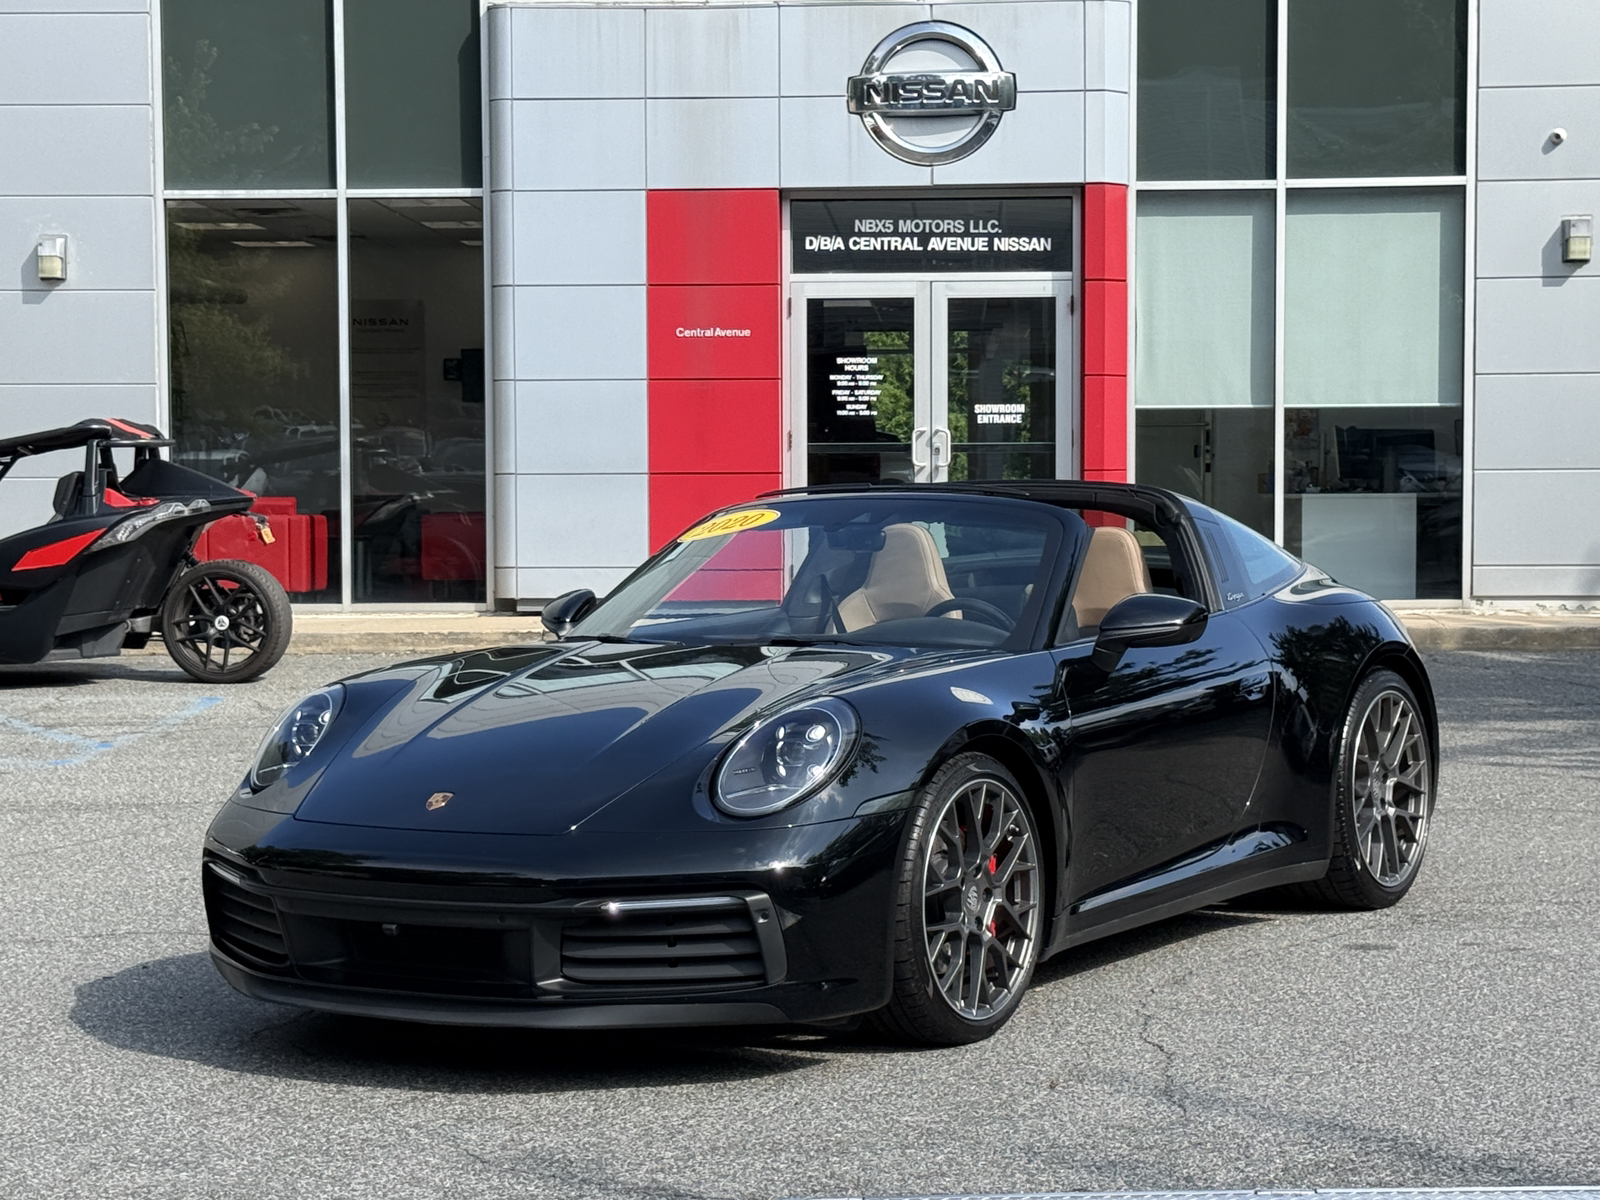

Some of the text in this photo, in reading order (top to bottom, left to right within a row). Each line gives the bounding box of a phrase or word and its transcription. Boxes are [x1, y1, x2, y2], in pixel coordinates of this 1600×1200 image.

[864, 79, 1000, 105] NISSAN
[854, 219, 894, 233] NBX5
[898, 219, 965, 233] MOTORS
[805, 235, 1052, 252] D/B/A CENTRAL AVENUE NISSAN
[352, 317, 409, 326] NISSAN
[675, 327, 751, 337] Central Avenue
[974, 404, 1025, 413] SHOWROOM
[977, 414, 1022, 424] ENTRANCE
[691, 513, 765, 538] 2020
